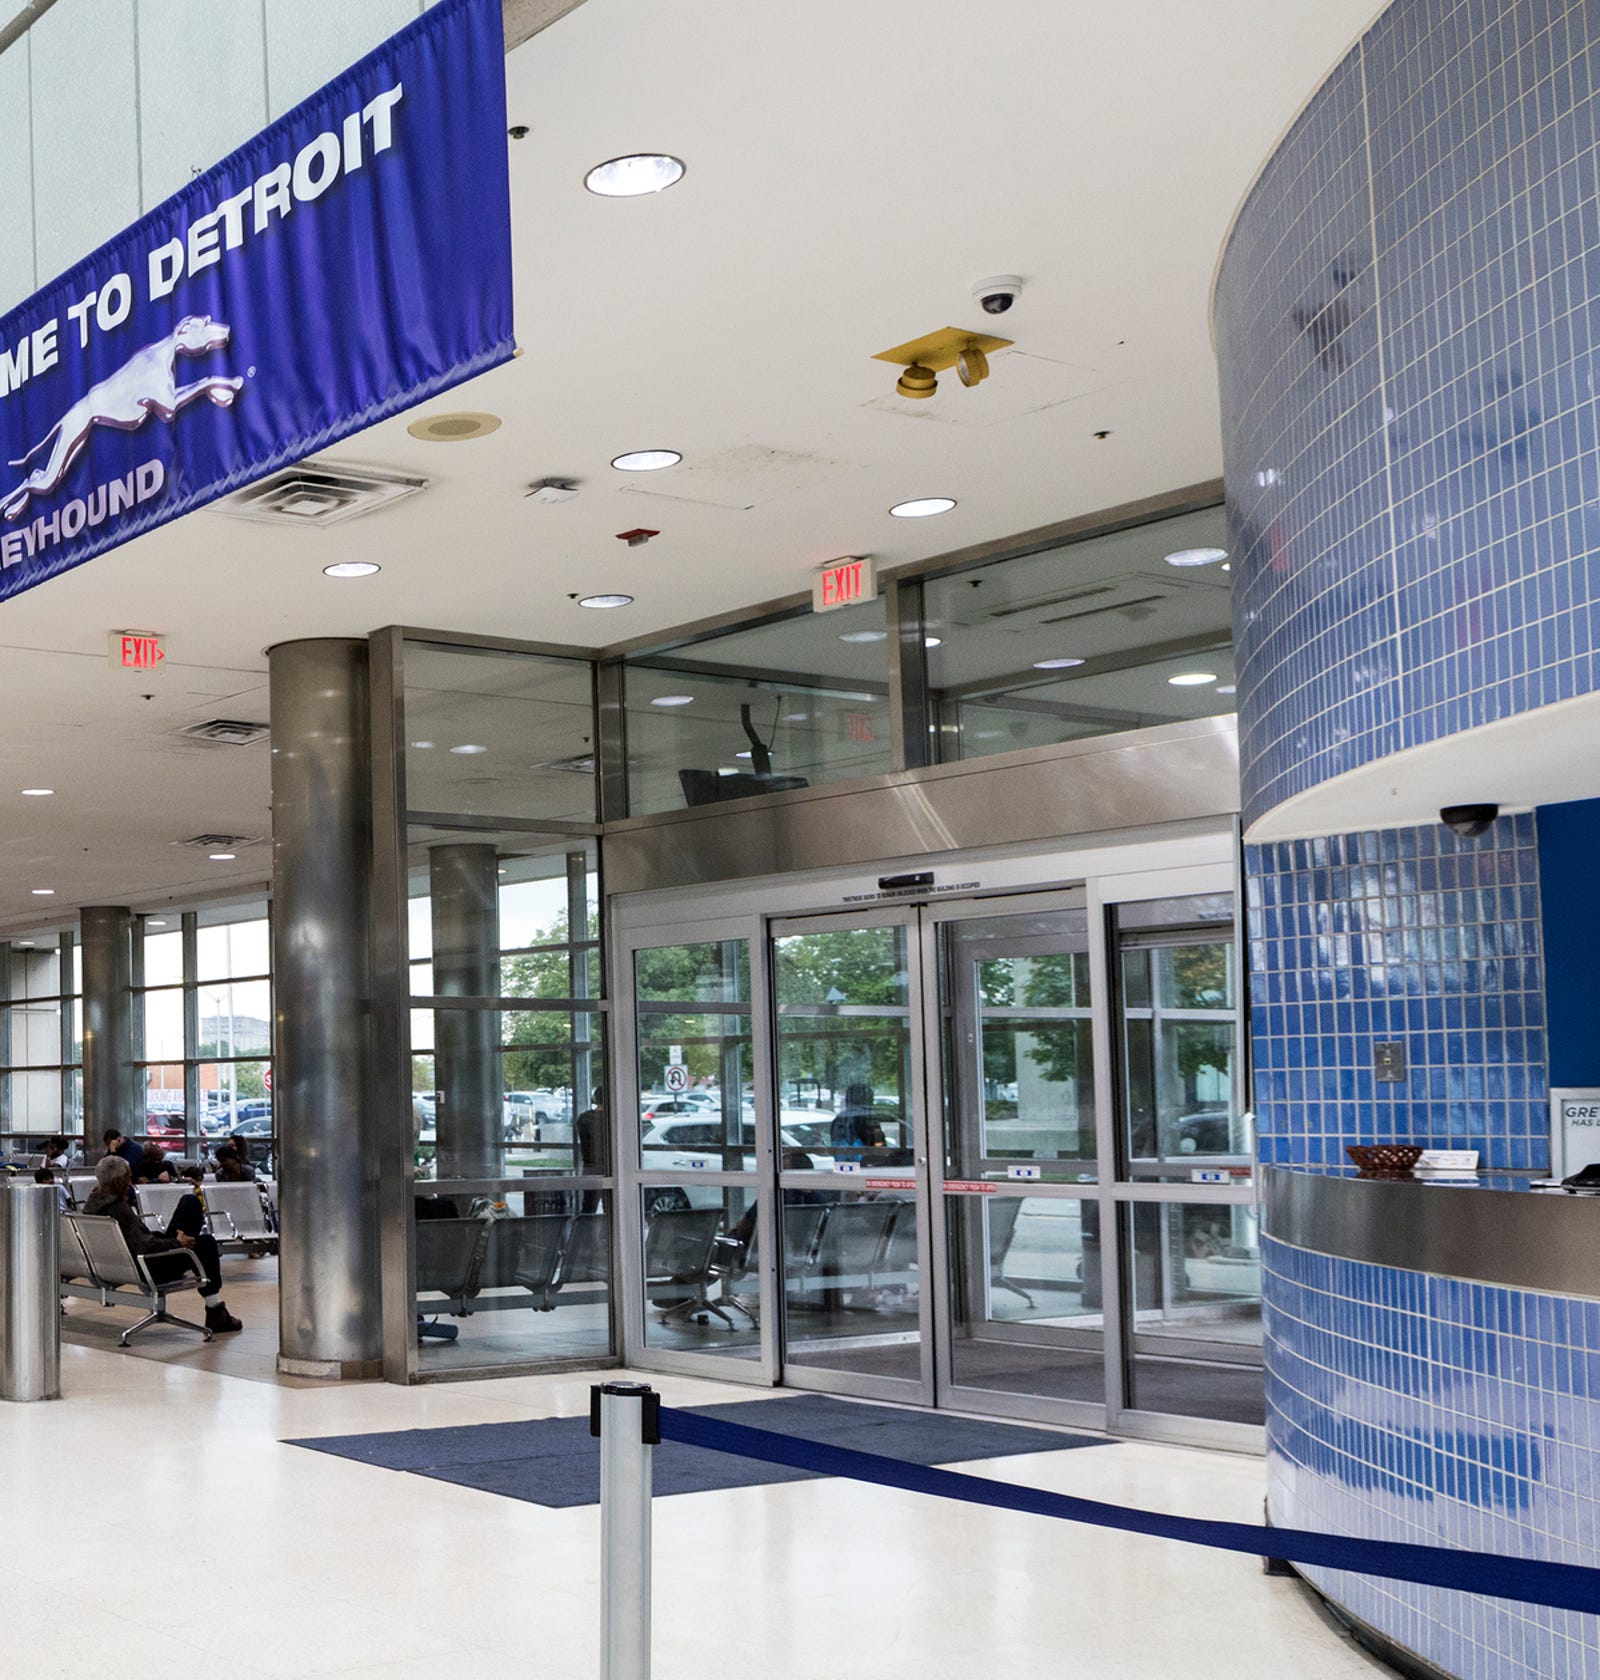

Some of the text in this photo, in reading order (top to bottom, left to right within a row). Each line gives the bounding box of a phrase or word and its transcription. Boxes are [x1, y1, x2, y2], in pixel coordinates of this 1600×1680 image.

[67, 273, 132, 349] TO
[147, 83, 403, 302] DETROIT
[822, 562, 863, 606] EXIT
[122, 636, 158, 669] EXIT
[1566, 1106, 1600, 1118] GRE
[1571, 1119, 1593, 1127] HAS
